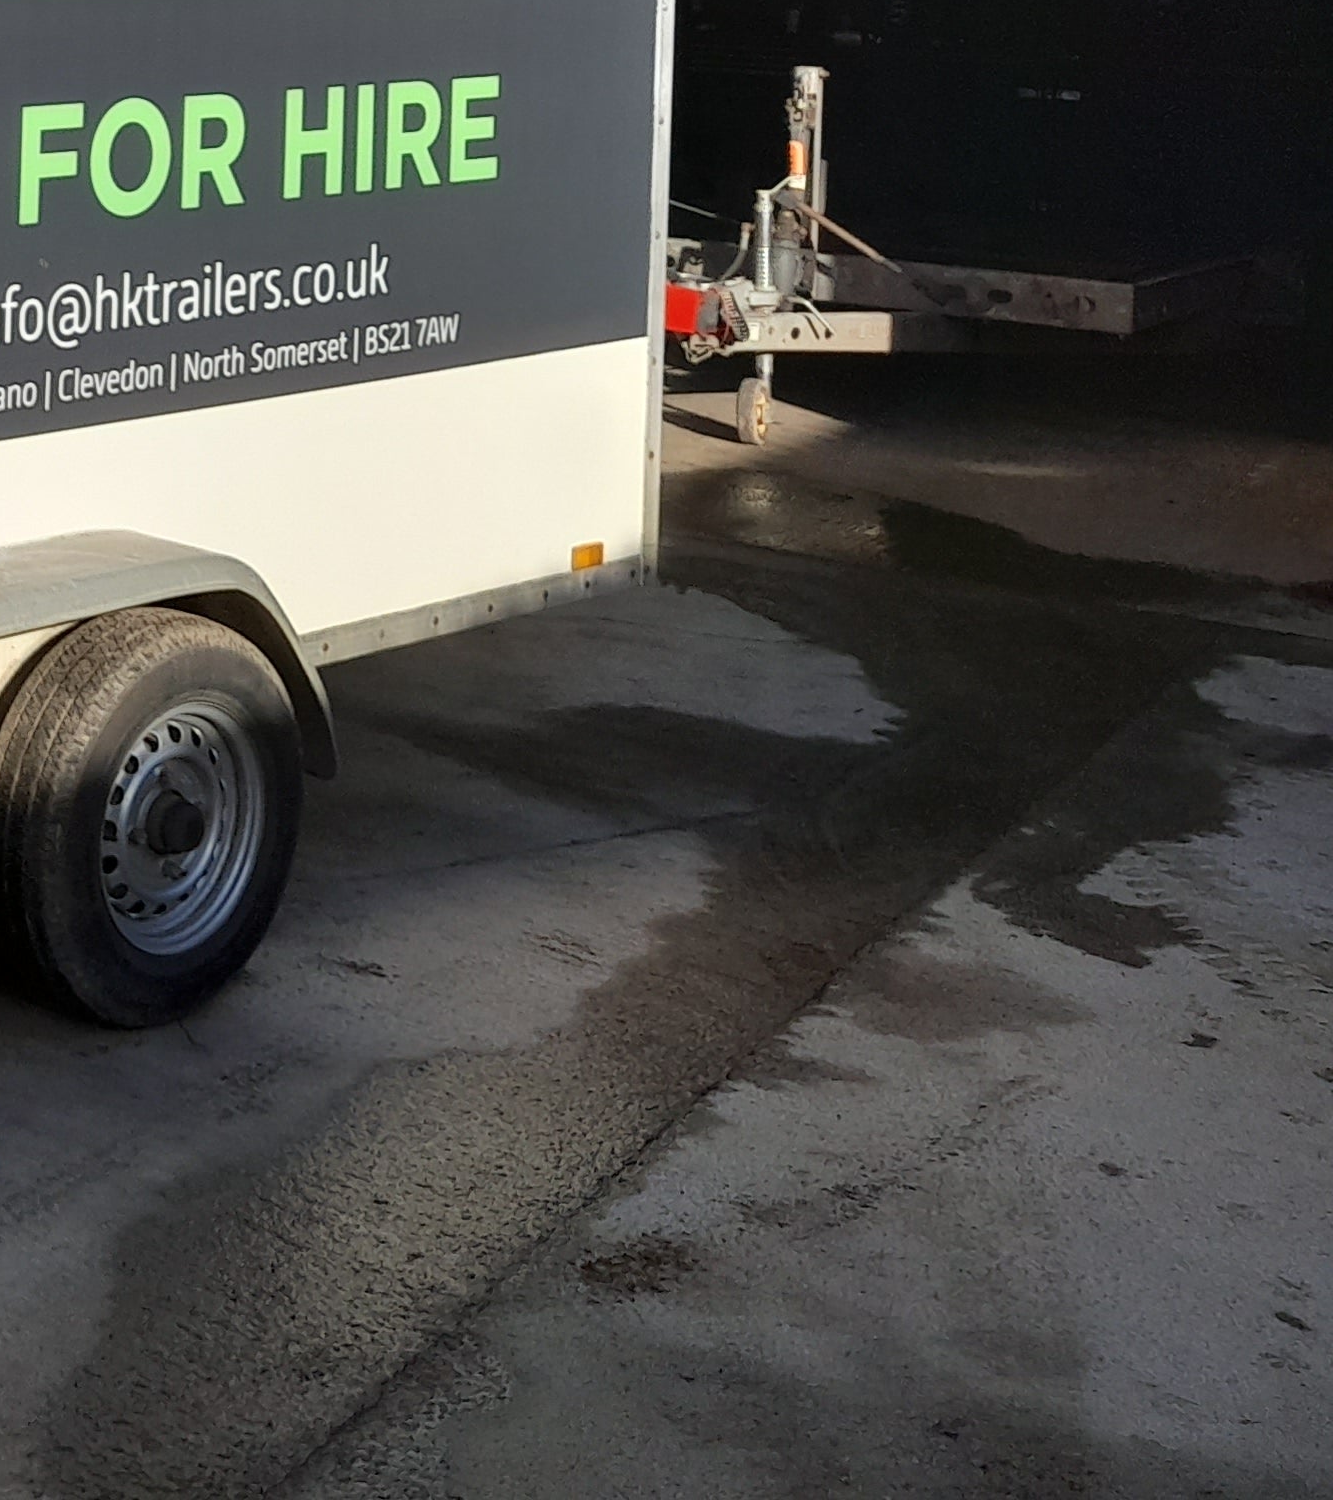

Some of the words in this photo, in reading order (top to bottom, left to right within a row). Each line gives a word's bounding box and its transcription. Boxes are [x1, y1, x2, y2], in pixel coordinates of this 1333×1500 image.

[18, 93, 247, 227] FOR
[282, 74, 502, 200] HIRE
[57, 358, 164, 402] Clevedon
[182, 343, 245, 384] North
[250, 330, 349, 375] Somerset
[364, 318, 412, 357] BS21
[415, 312, 460, 347] 7AW
